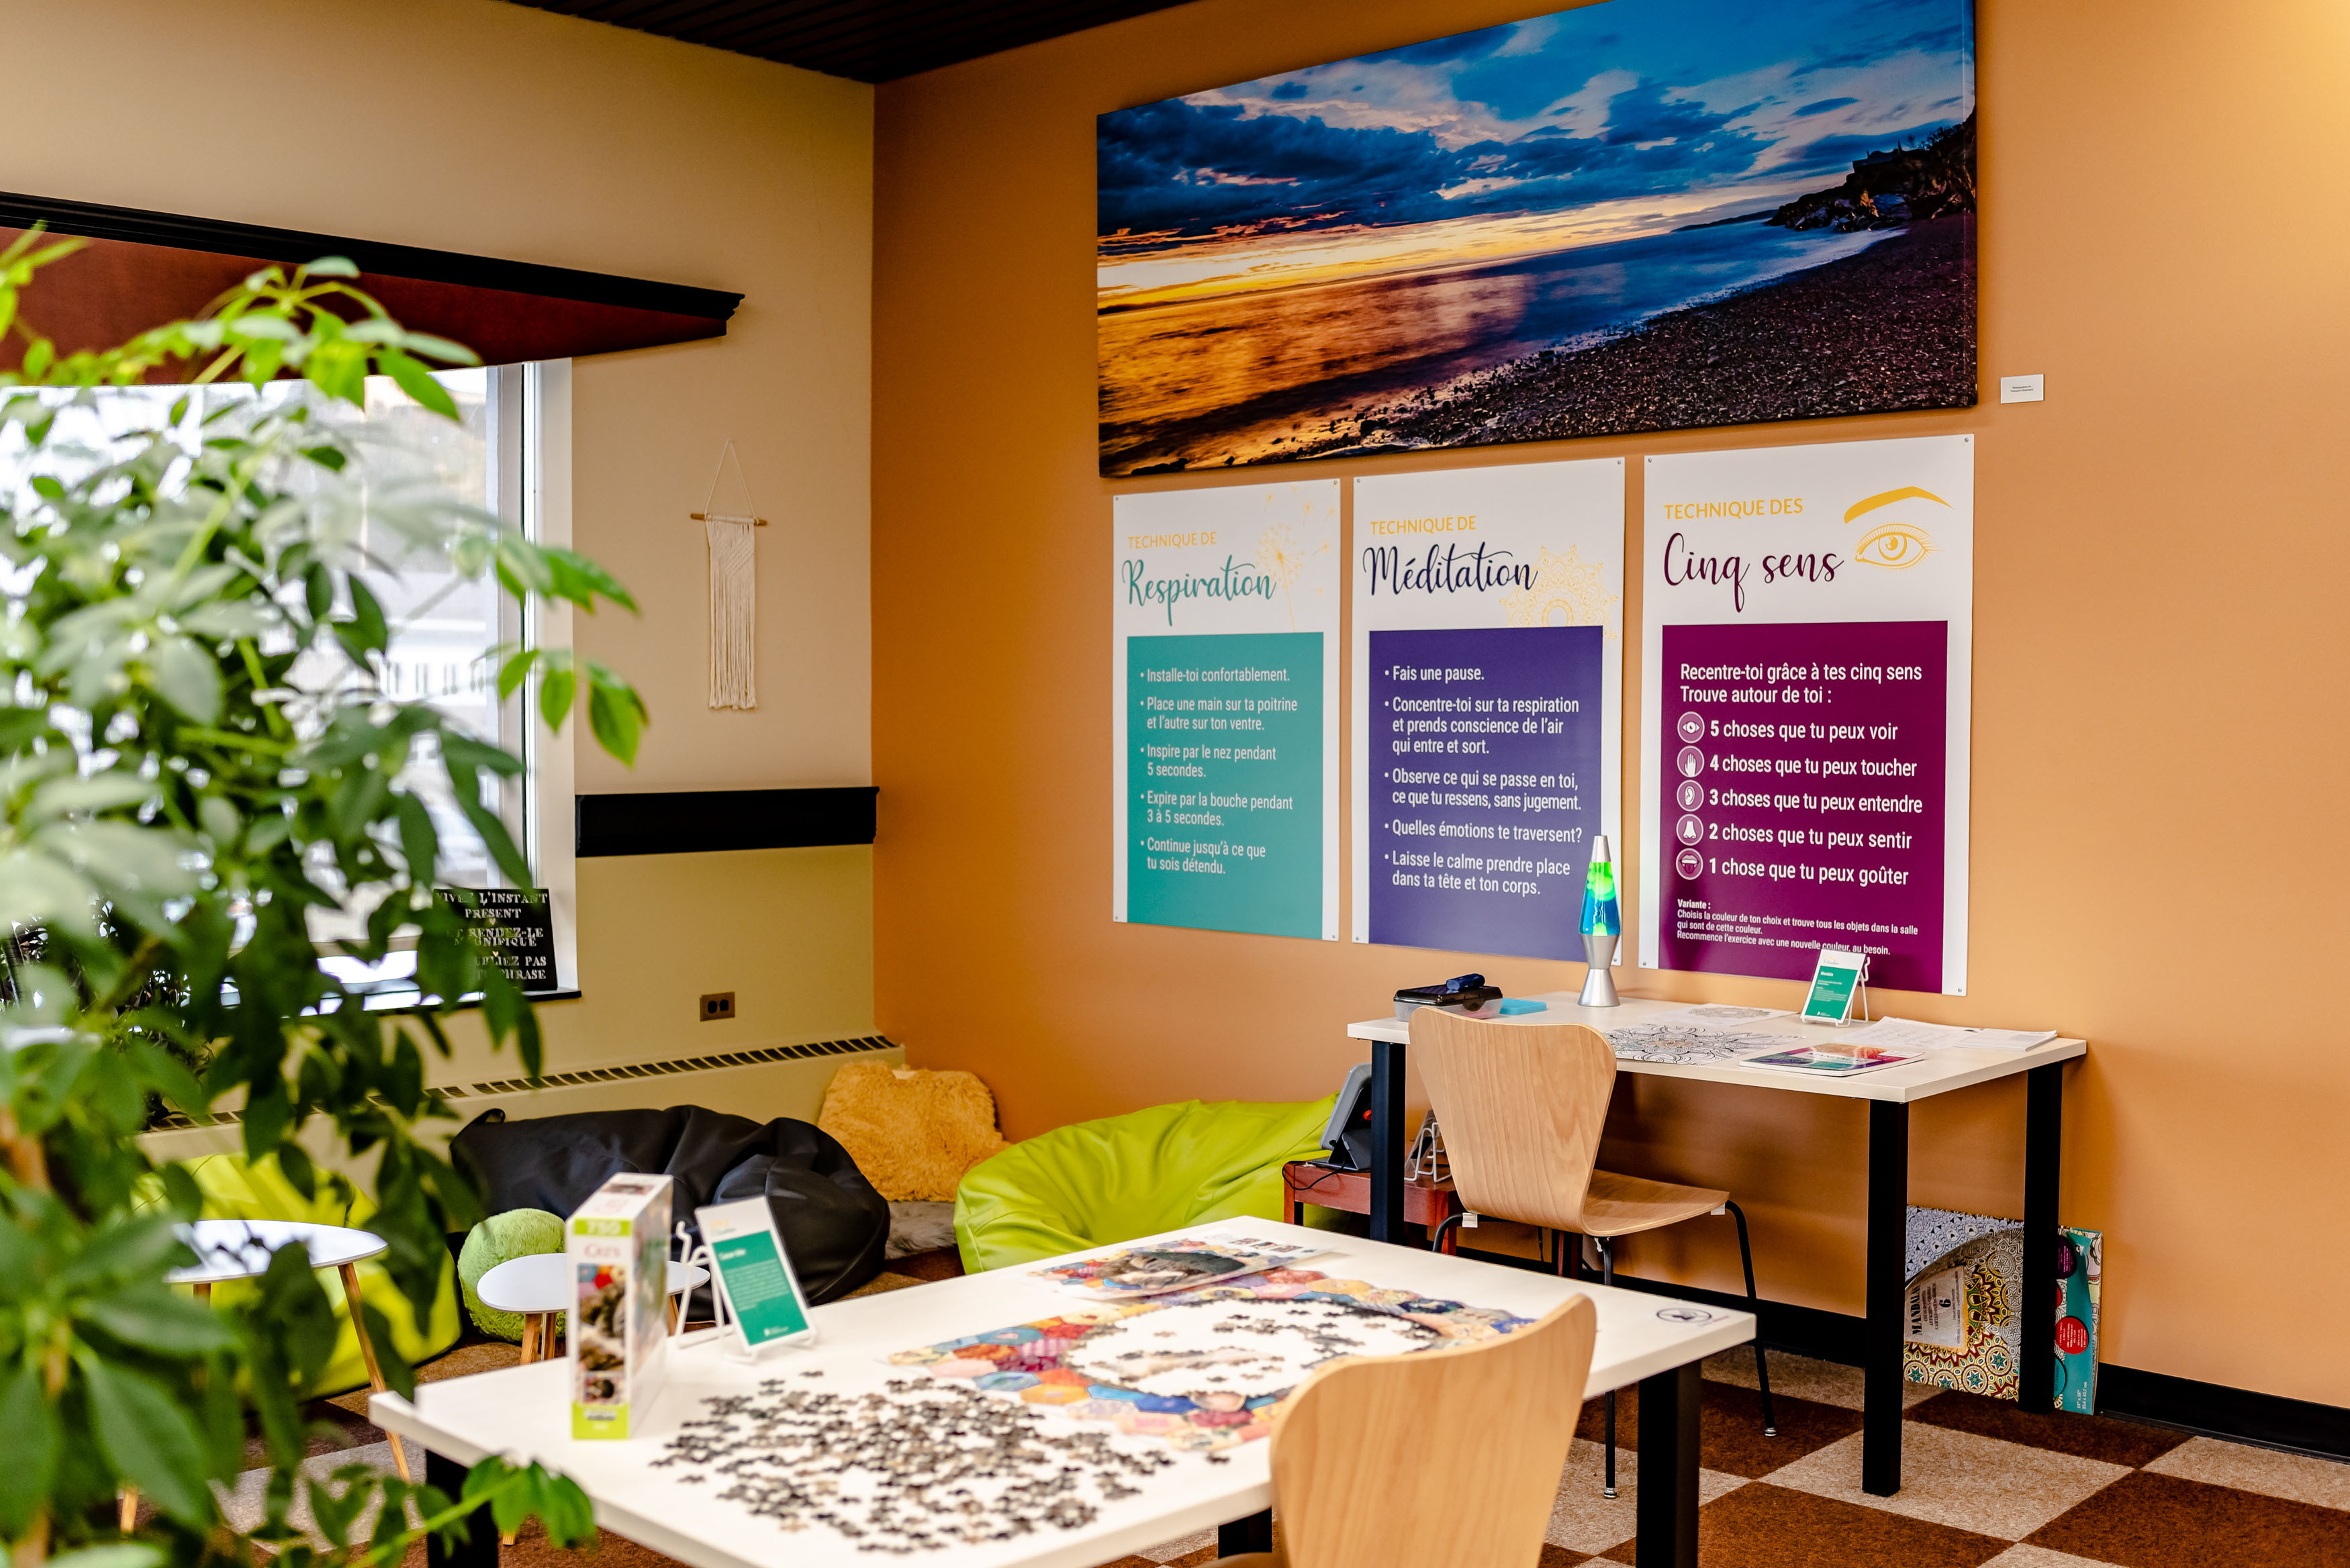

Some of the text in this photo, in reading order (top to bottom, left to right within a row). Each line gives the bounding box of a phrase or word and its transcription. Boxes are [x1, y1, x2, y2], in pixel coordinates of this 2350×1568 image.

[1663, 497, 1803, 520] TECHNIQUE DES
[1369, 515, 1476, 536] TECHNIQUE DE
[1127, 531, 1217, 550] TECHNIQUE DE
[1362, 541, 1538, 596] Méditation
[1664, 532, 1844, 613] Cinq sens
[1122, 554, 1278, 628] Respiration
[1147, 667, 1290, 683] Installe-toi confortablement.
[1393, 665, 1485, 685] Fais une pause.
[1681, 662, 1922, 685] Recentre-toi grâce à tes cinq sens
[1680, 685, 1823, 703] Trouve autour de toi
[1147, 696, 1298, 715] Place une main sur ta poitrine
[1393, 696, 1579, 716] Concentre-toi sur ta respiration
[1147, 715, 1265, 731] et l'autre sur ton ventre.
[1392, 716, 1564, 736] et prends conscience de l'air
[1710, 719, 1898, 743] 5 choses que tu peux voir
[1147, 744, 1276, 763] Inspire par le nez pendant
[1392, 737, 1490, 756] qui entre et sort.
[1147, 762, 1207, 778] 5 secondes.
[1393, 768, 1579, 791] Observe ce qui se passe en toi,
[1147, 790, 1293, 812] Expire par la bouche pendant
[1392, 790, 1582, 812] ce que tu ressens, sans jugement.
[1147, 808, 1225, 826] 3 à 5 secondes.
[1393, 819, 1583, 843] Quelles émotions te traversent?
[1147, 836, 1266, 861] Continue jusqu'à ce que
[1147, 856, 1226, 875] tu sois détendu.
[1393, 850, 1570, 877] Laisse le calme prendre place
[1709, 857, 1909, 887] 1 chose que tu peux goûter
[1392, 870, 1541, 897] dans ta tête et ton corps.
[465, 908, 522, 919] PRESENT
[1677, 898, 1707, 910] Variante
[1677, 909, 1918, 935] Choisis la couleur de ton choix et trouve tous les objets dans la salle
[1677, 920, 1762, 934] qui sont de cette couleur.
[1677, 930, 1724, 942] Recommence
[1724, 933, 1757, 945] l'exercice
[1758, 938, 1775, 946] avec
[1775, 939, 1790, 948] une
[1790, 940, 1821, 950] nouvelle
[1852, 945, 1863, 953] au
[1863, 944, 1891, 955] besoin.
[525, 956, 547, 967] PAS
[1938, 1298, 1952, 1308] 6
